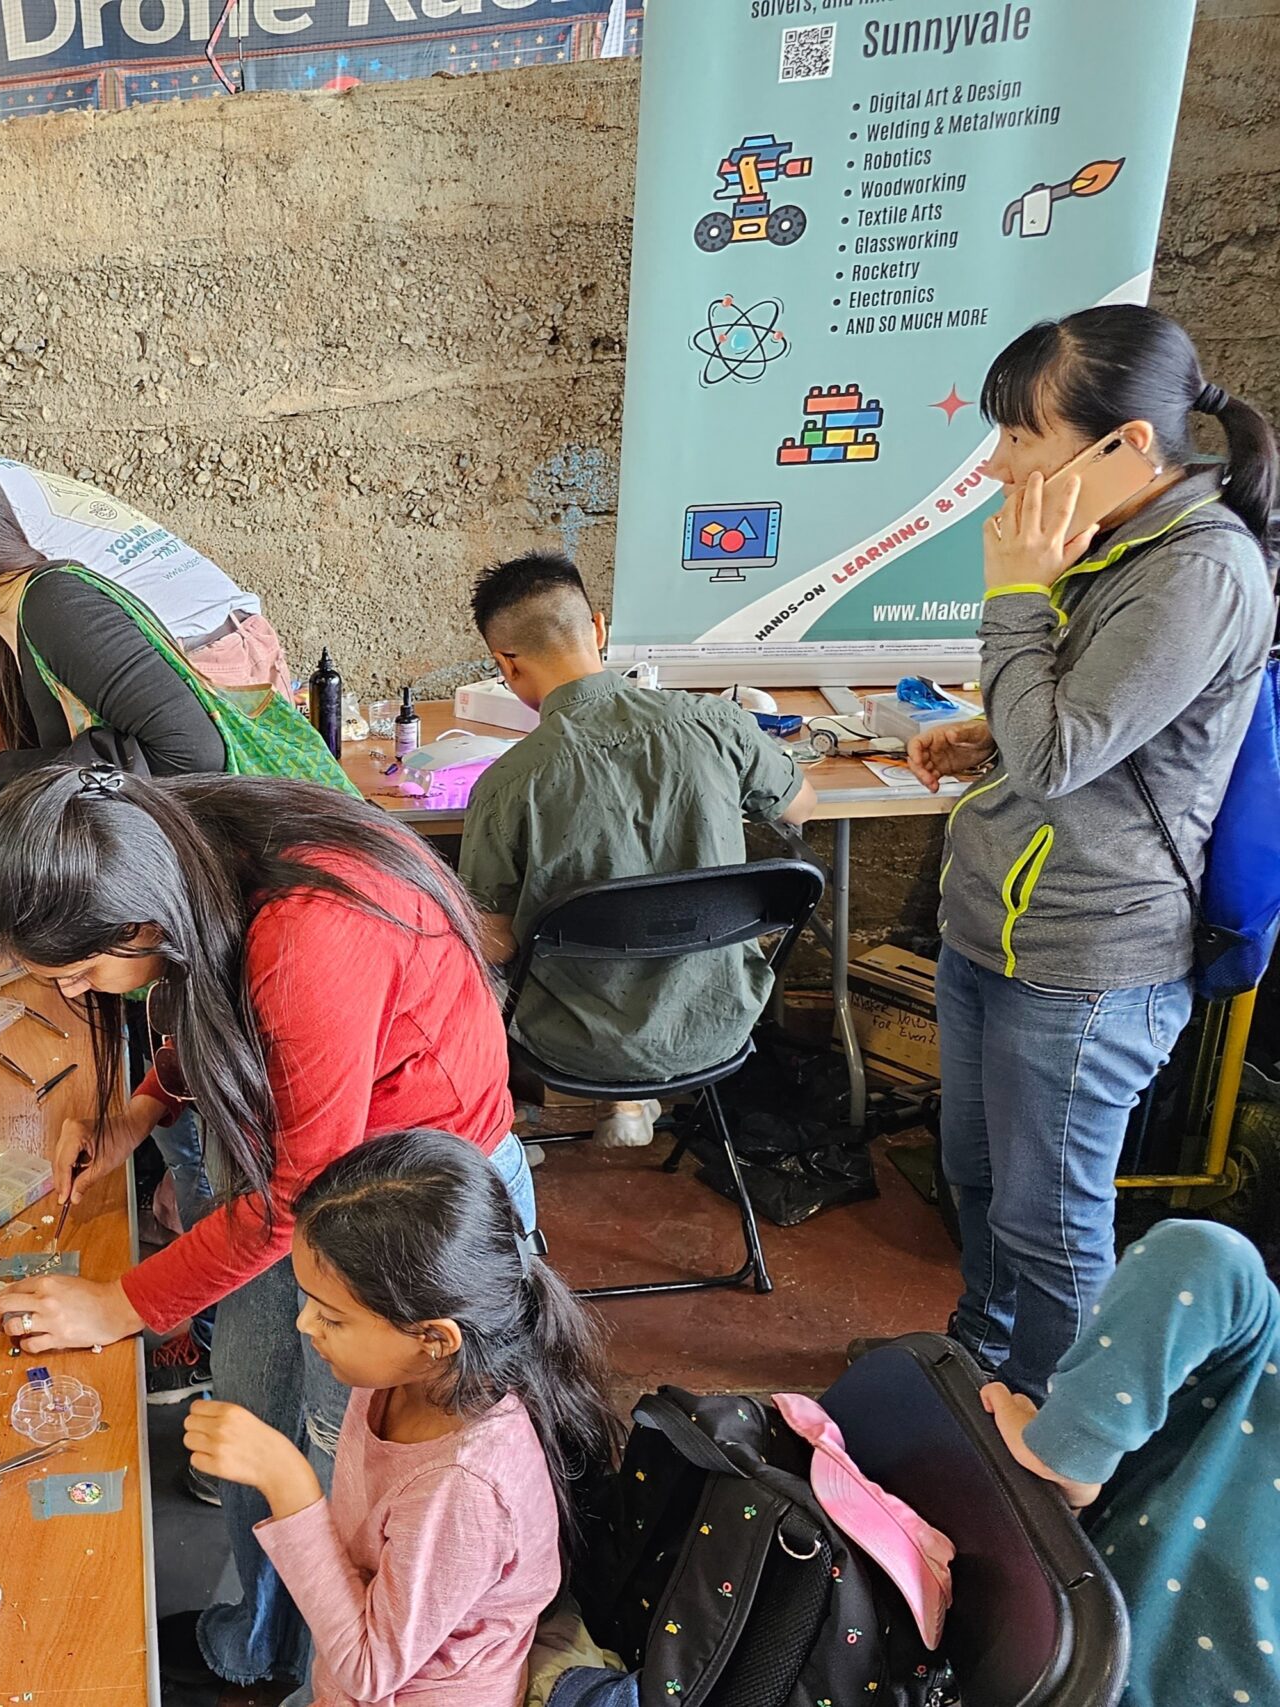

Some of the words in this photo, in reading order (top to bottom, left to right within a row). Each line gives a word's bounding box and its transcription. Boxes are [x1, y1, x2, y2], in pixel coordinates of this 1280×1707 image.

[862, 3, 1032, 58] Sunnyvale
[869, 89, 921, 113] Digital
[925, 86, 949, 107] Art
[952, 85, 963, 104] &
[966, 80, 1022, 103] Design
[867, 120, 930, 142] Welding
[933, 116, 945, 135] &
[948, 105, 1061, 134] Metalworking
[863, 147, 932, 171] Robotics
[861, 173, 967, 199] Woodworking
[858, 205, 907, 227] Textile
[910, 203, 942, 222] Arts
[855, 229, 959, 254] Glassworking
[852, 261, 920, 281] Rocketry
[849, 286, 935, 308] Electronics
[846, 317, 875, 335] AND
[878, 315, 896, 333] SO
[900, 312, 943, 331] MUCH
[946, 308, 989, 328] MORE
[105, 533, 133, 556] YOU
[754, 583, 826, 641] HANDS-ON
[832, 516, 930, 584] LEARNING
[935, 498, 954, 514] &
[873, 601, 983, 622] www.Maker
